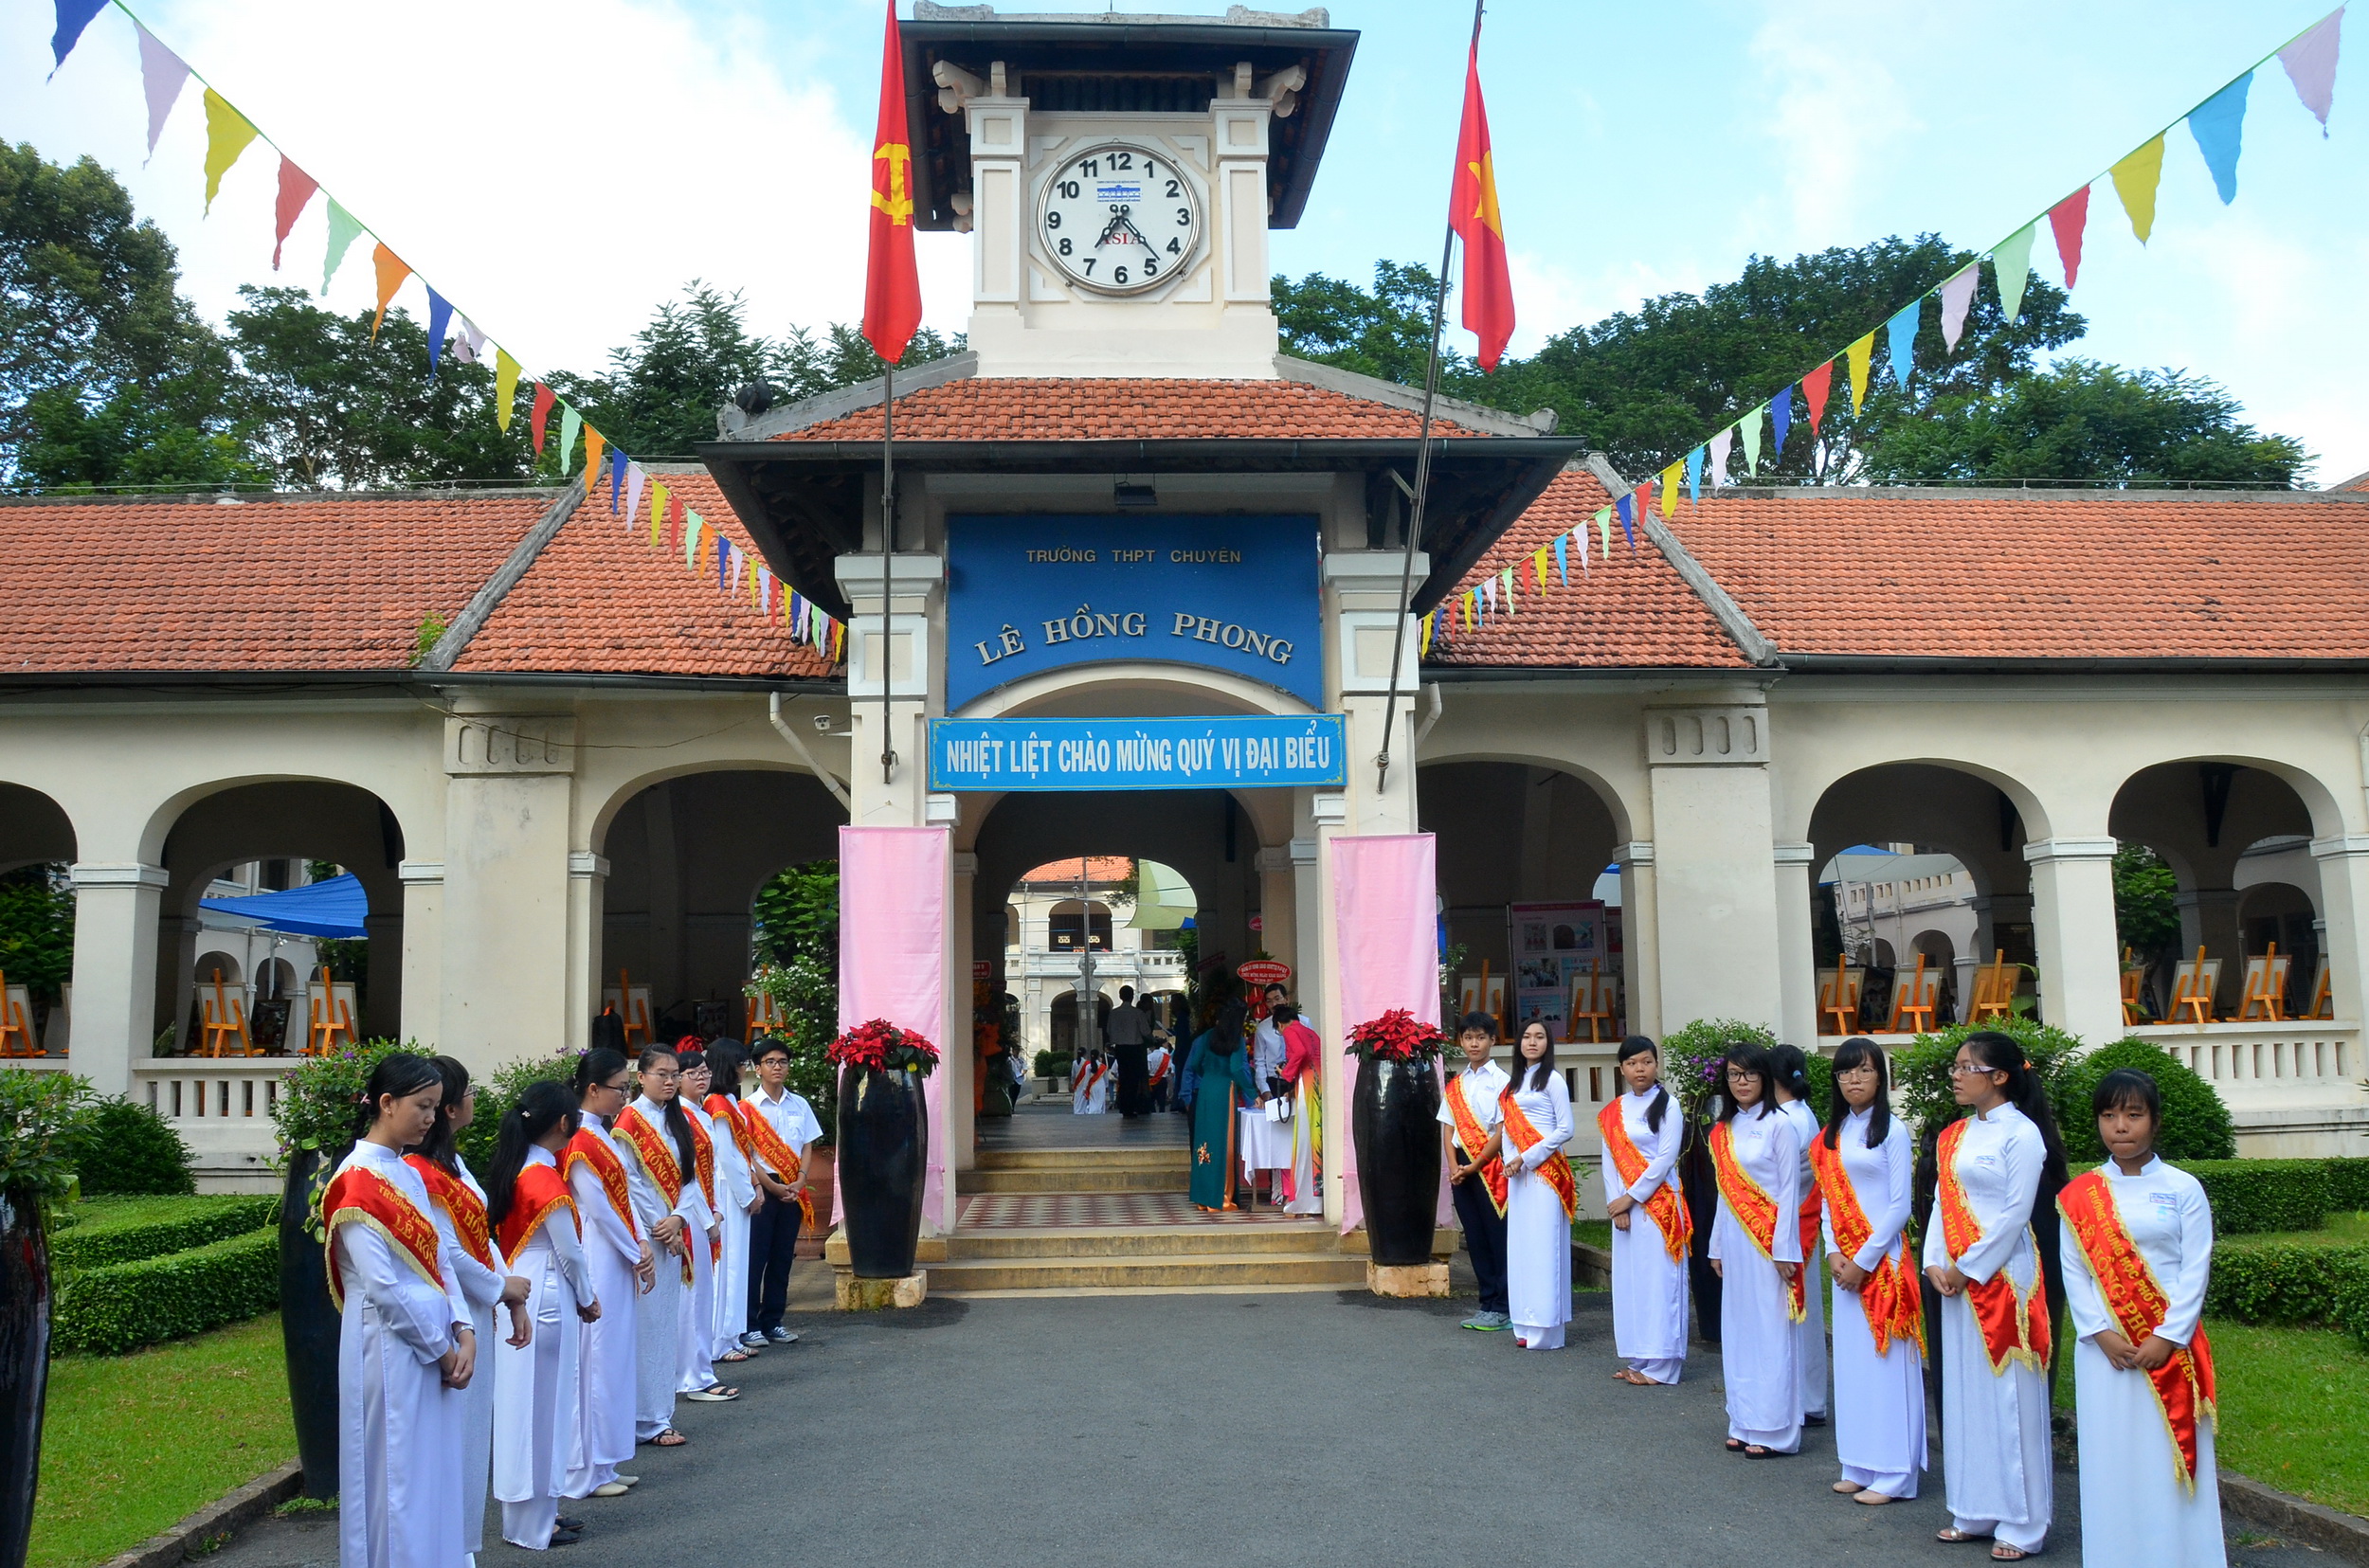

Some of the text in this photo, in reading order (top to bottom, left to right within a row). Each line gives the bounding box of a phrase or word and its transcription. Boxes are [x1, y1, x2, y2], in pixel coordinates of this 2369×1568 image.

[1078, 159, 1098, 178] 11
[1106, 153, 1132, 171] 12
[1144, 160, 1154, 178] 1
[1057, 181, 1080, 199] 10
[1166, 180, 1180, 198] 2
[1047, 211, 1061, 229] 9
[1177, 207, 1190, 226] 3
[1059, 238, 1073, 256] 8
[1166, 237, 1181, 255] 4
[1083, 258, 1096, 276] 7
[1114, 266, 1128, 284] 6
[1144, 258, 1157, 276] 5
[1026, 545, 1241, 564] TRƯỜNG THPT CHUYÊN
[974, 604, 1294, 666] LÊ HỒNG PHONG
[947, 720, 1330, 780] NHIỆT LIỆT CHÀO MỪNG QUÝ VỊ ĐẠI BIỂU
[650, 1133, 666, 1155] TRUNG
[784, 1164, 797, 1181] PHO
[1540, 1162, 1560, 1181] ONG
[1619, 1159, 1637, 1182] HỒN
[1829, 1171, 1844, 1199] TRUNG
[1839, 1200, 1853, 1218] HỌC
[1650, 1196, 1672, 1223] ONG
[392, 1214, 414, 1240] LÊ
[411, 1211, 433, 1238] TRUNG
[1736, 1200, 1774, 1246] PHONG
[1943, 1213, 1965, 1257] PHON
[2100, 1220, 2125, 1256] TRUNG
[2119, 1256, 2140, 1280] HỌC
[2134, 1279, 2161, 1302] PHỔ
[1876, 1266, 1891, 1299] UYÊN
[2091, 1243, 2127, 1301] HỒNG
[2121, 1299, 2153, 1343] PHO
